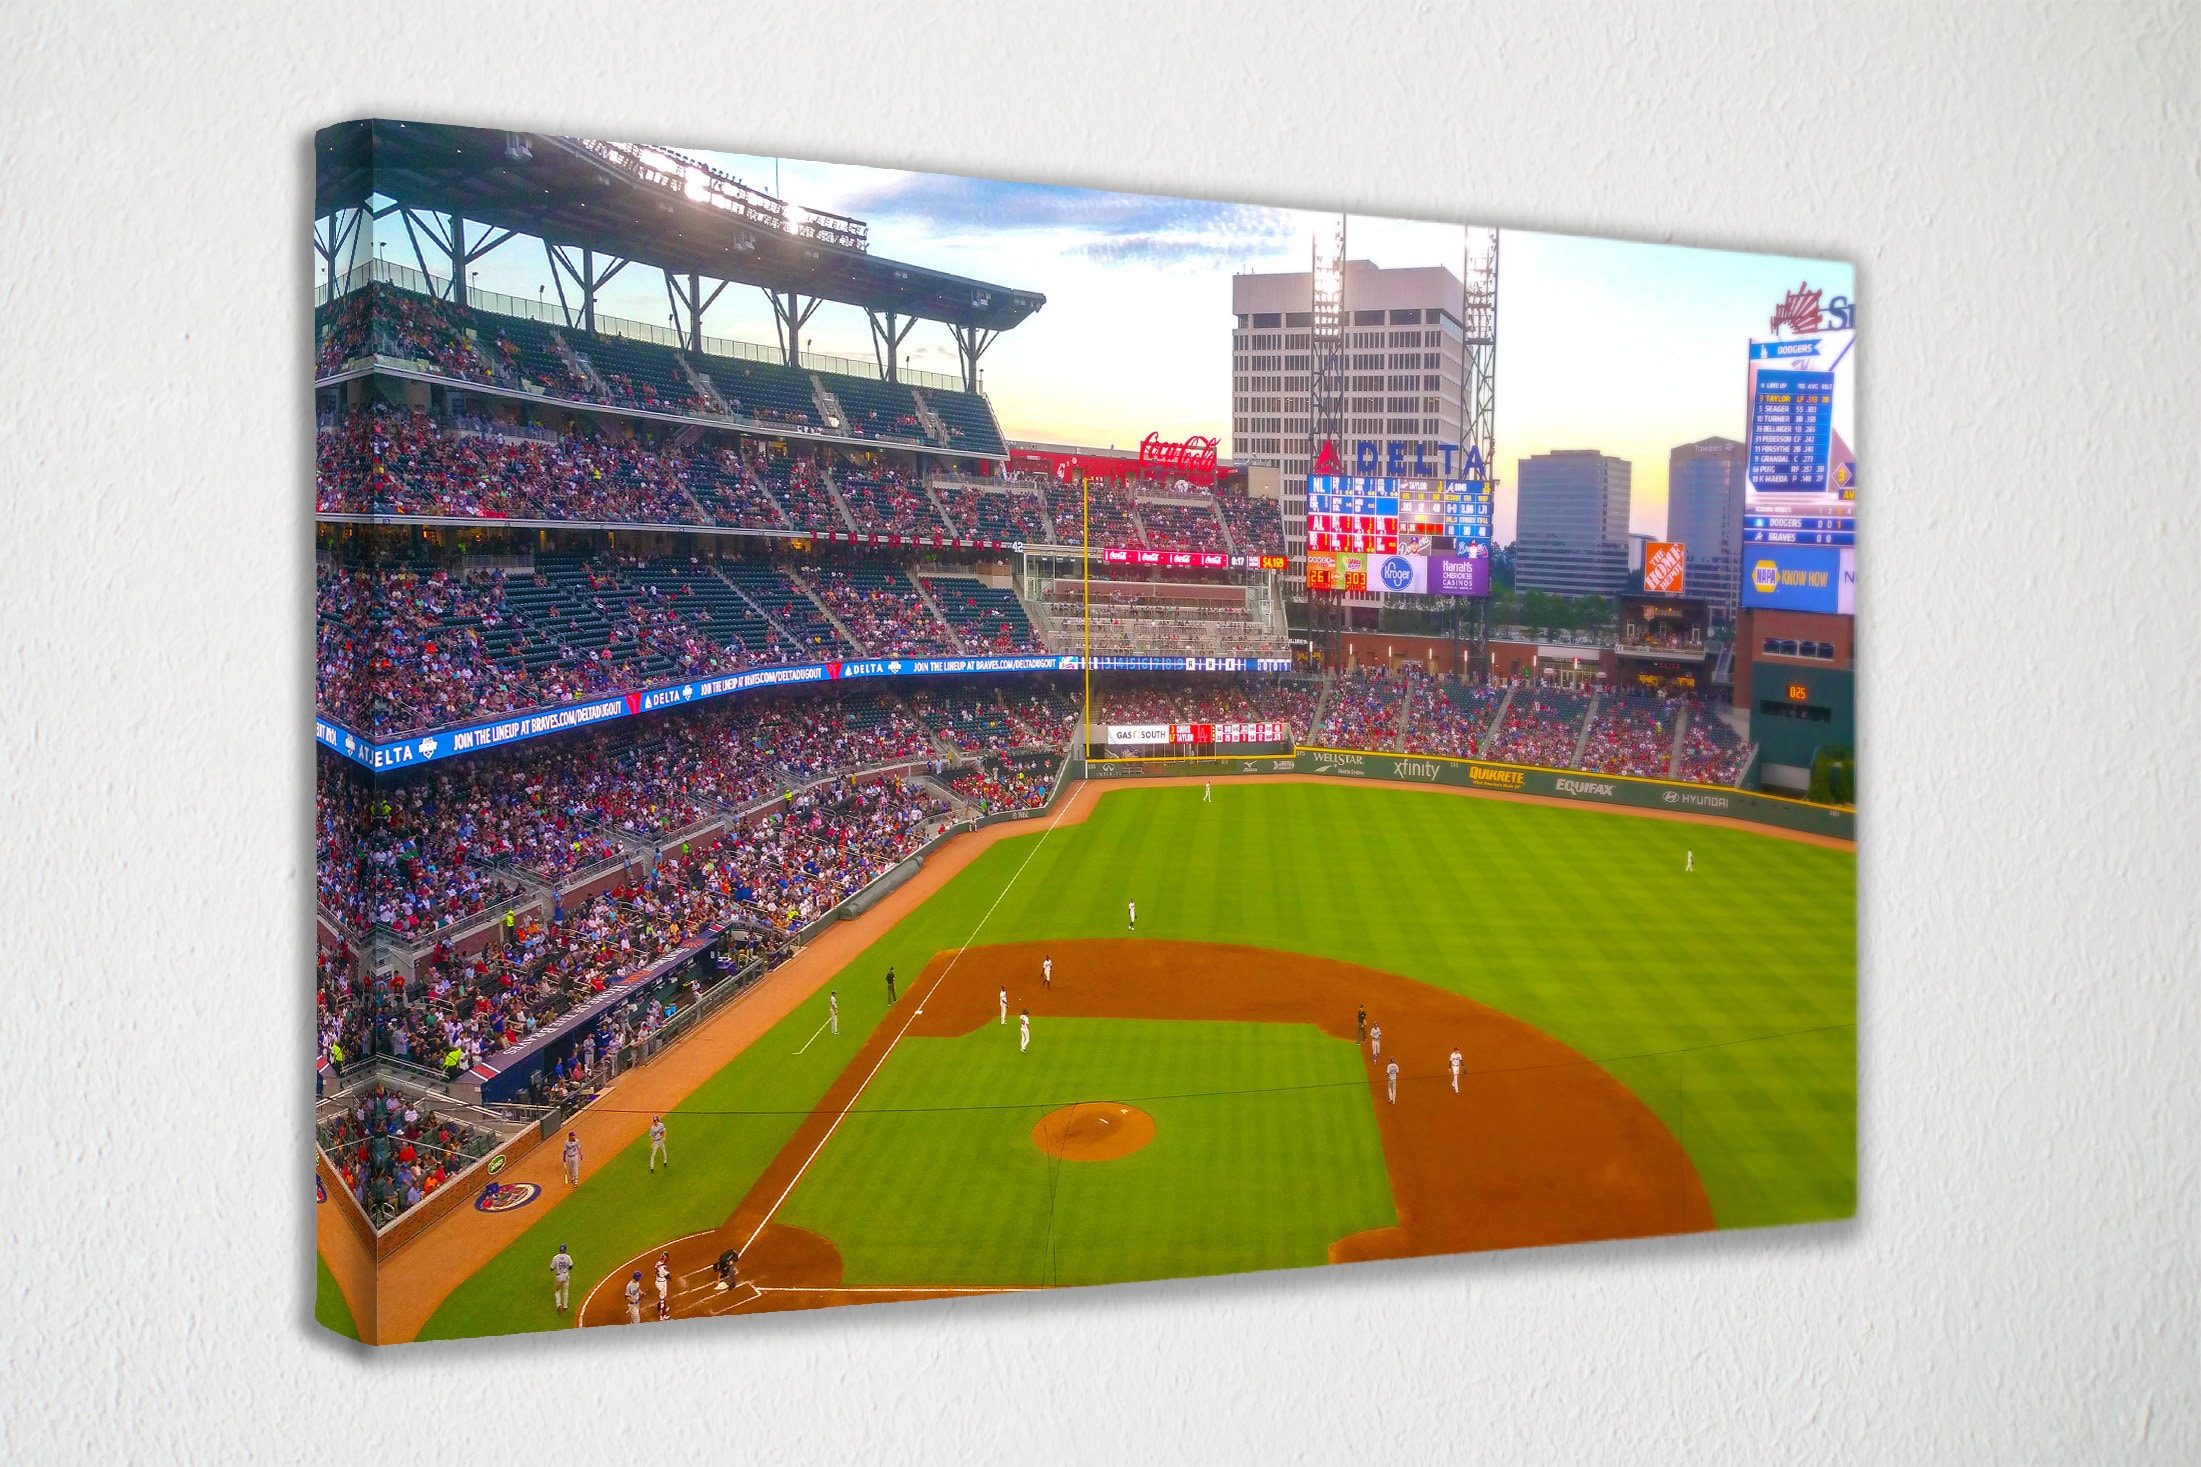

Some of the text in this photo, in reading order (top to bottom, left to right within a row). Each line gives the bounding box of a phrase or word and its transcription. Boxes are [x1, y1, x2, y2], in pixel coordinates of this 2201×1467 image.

[1778, 344, 1812, 354] DODGERS
[1140, 432, 1221, 472] Coca-Cola
[1357, 442, 1486, 478] DELTA
[1839, 469, 1845, 481] 3
[1313, 478, 1325, 492] NL
[1409, 482, 1427, 490] TAYLOR
[1313, 516, 1324, 530] AL
[1770, 518, 1802, 527] DODGERS
[1768, 533, 1796, 541] BRAVES
[1012, 541, 1023, 553] 42
[1231, 556, 1244, 566] 8:17
[1650, 548, 1665, 567] THE
[1384, 561, 1410, 587] Kroger
[1646, 544, 1684, 590] HOME
[1347, 573, 1366, 584] 303
[1660, 561, 1684, 590] DEPOT
[1757, 569, 1828, 587] NAPA KNOW HOW
[854, 659, 1056, 674] DELTA JOIN THE LINEUP AT BRAVES.COM/DELTADUGOUT
[1129, 658, 1136, 669] 5
[1141, 658, 1148, 669] 6
[1153, 659, 1160, 669] 7
[1165, 659, 1172, 669] 8
[1177, 659, 1184, 670] 9
[653, 690, 680, 706] DELTA
[701, 682, 712, 696] JOIN
[712, 681, 722, 694] THE
[722, 678, 738, 692] LINEUP
[745, 668, 822, 688] BRAVES.COM/DELTADUGOUT
[454, 732, 473, 750] JOIN
[474, 730, 491, 745] THE
[492, 723, 519, 742] LINEUP
[520, 720, 530, 735] AT
[532, 701, 622, 733] BRAVES.COM/DELTADUGOUT
[1142, 731, 1166, 739] SOUTH
[1170, 734, 1194, 742] LF TAYLOR
[1313, 753, 1364, 765] WELLSTAR
[1394, 759, 1440, 781] xfinity
[1469, 766, 1524, 784] QUIKRETE
[1556, 778, 1614, 796] EQUIFAX
[1682, 794, 1728, 808] HYUNDAI
[503, 1027, 560, 1055] BRAVES
